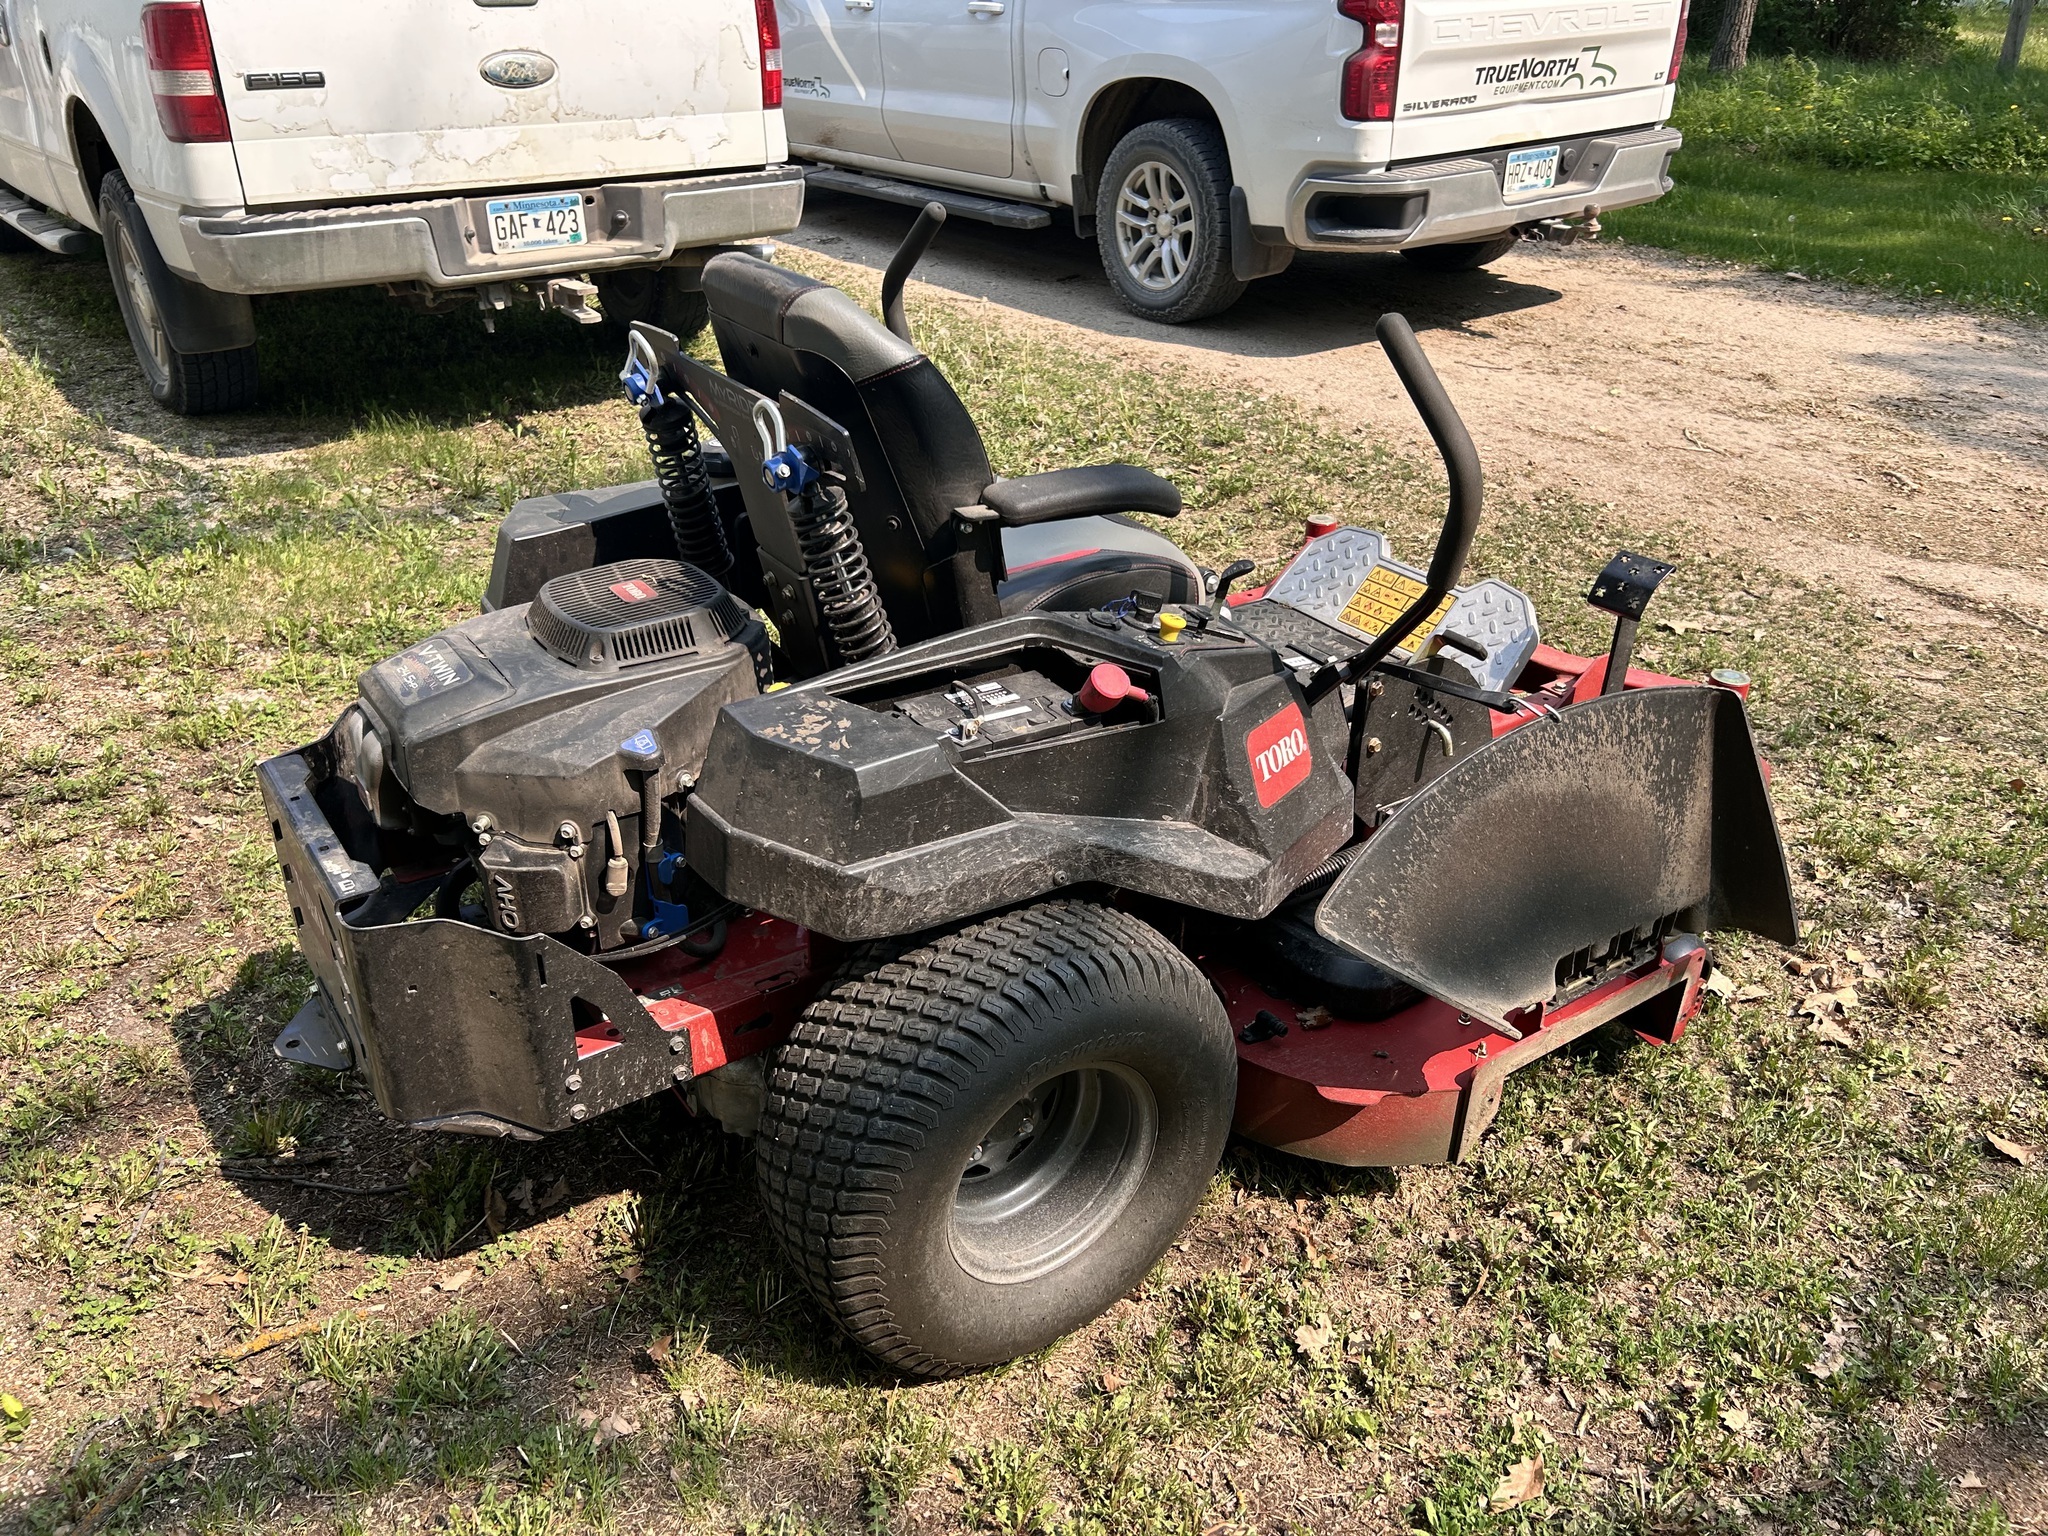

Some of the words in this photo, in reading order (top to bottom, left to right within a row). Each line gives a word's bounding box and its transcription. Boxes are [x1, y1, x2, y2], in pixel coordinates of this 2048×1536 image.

[1432, 1, 1672, 44] CHEVROLET
[501, 60, 540, 79] Ford
[1654, 71, 1665, 80] LT
[246, 71, 325, 89] F-150
[1493, 79, 1560, 96] EQUIPMENT.COM
[1402, 95, 1478, 112] SILVERADO
[1507, 162, 1528, 185] HRZ
[1533, 158, 1553, 180] 408
[512, 200, 557, 211] Minnesota
[494, 213, 529, 240] GAF
[546, 209, 579, 236] 423
[622, 583, 647, 599] TORO
[1255, 728, 1304, 782] TORO
[495, 874, 519, 929] OHV
